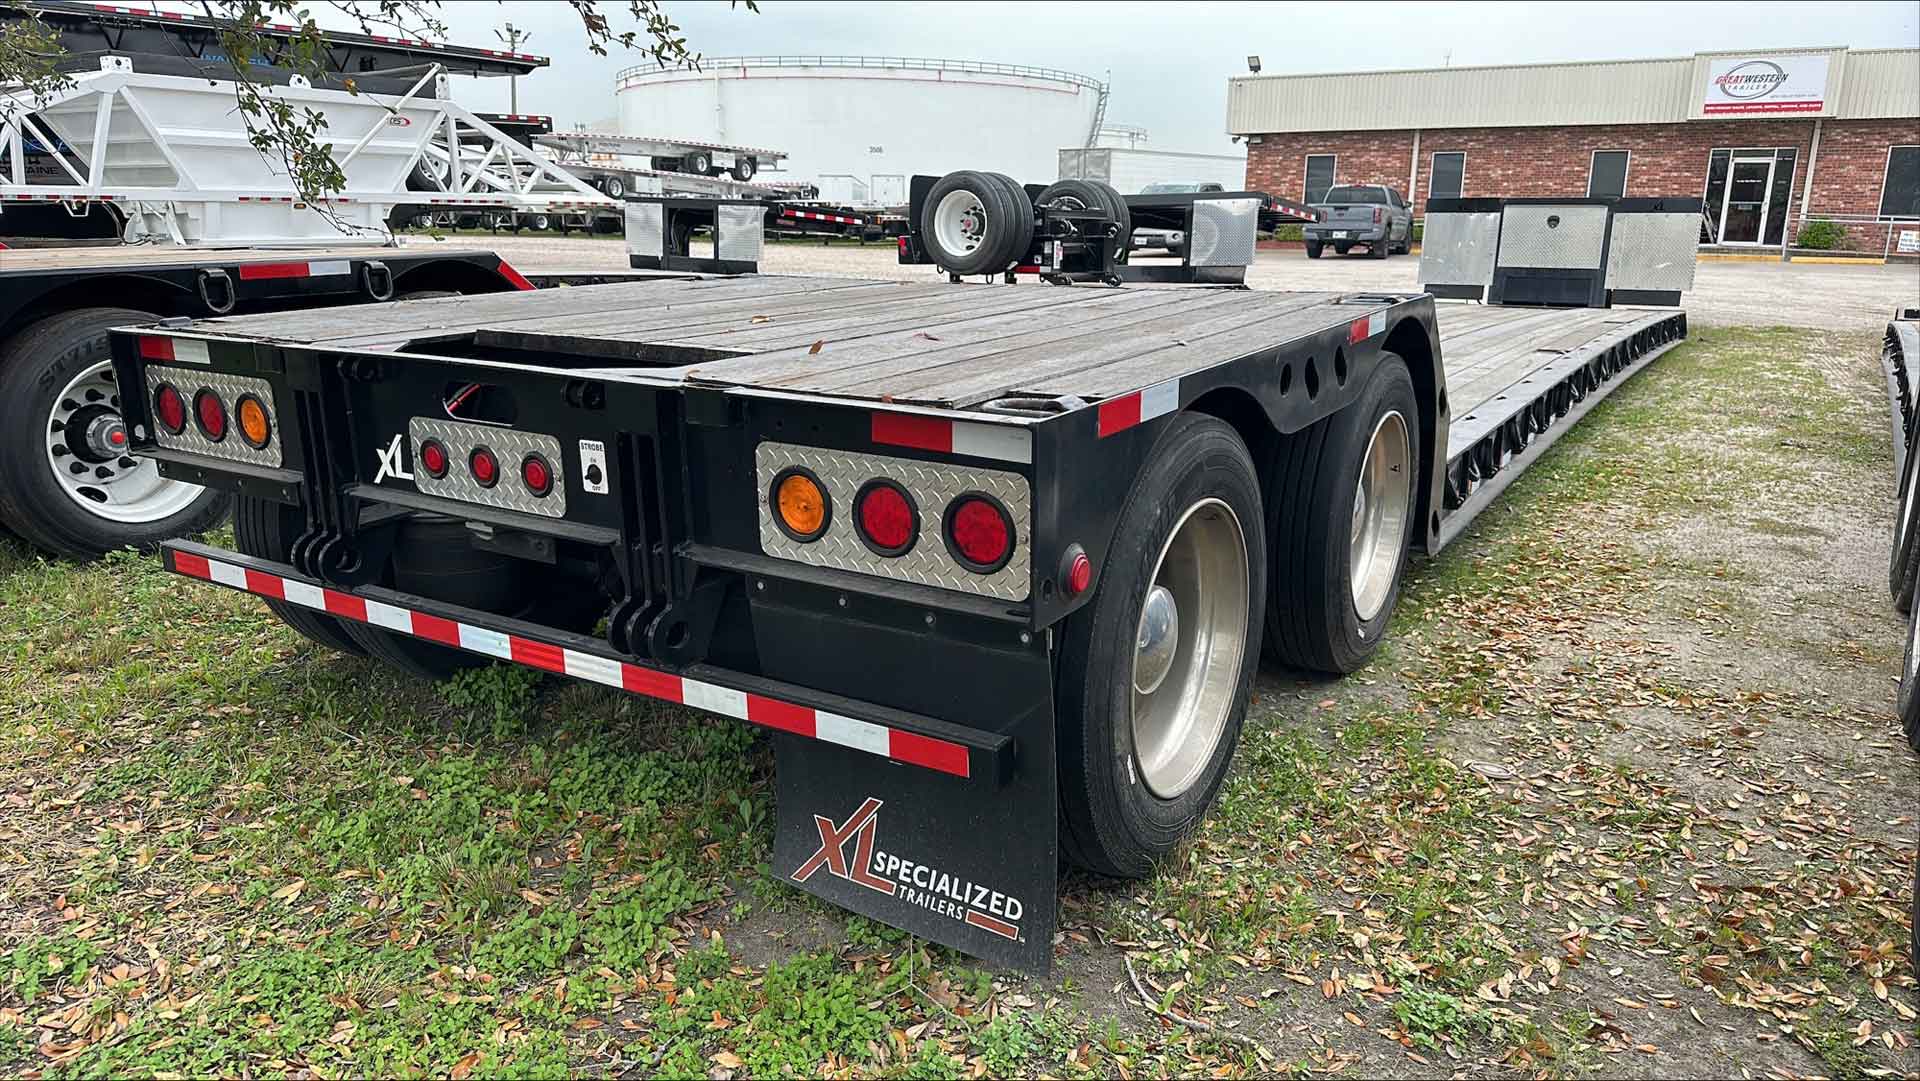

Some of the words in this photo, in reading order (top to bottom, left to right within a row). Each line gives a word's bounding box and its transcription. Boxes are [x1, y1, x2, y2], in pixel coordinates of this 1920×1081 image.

[374, 433, 414, 484] XL
[580, 442, 604, 452] STROBE
[790, 796, 897, 896] XL
[873, 851, 1023, 921] SPECIALIZED
[898, 885, 964, 921] TRAILERS
